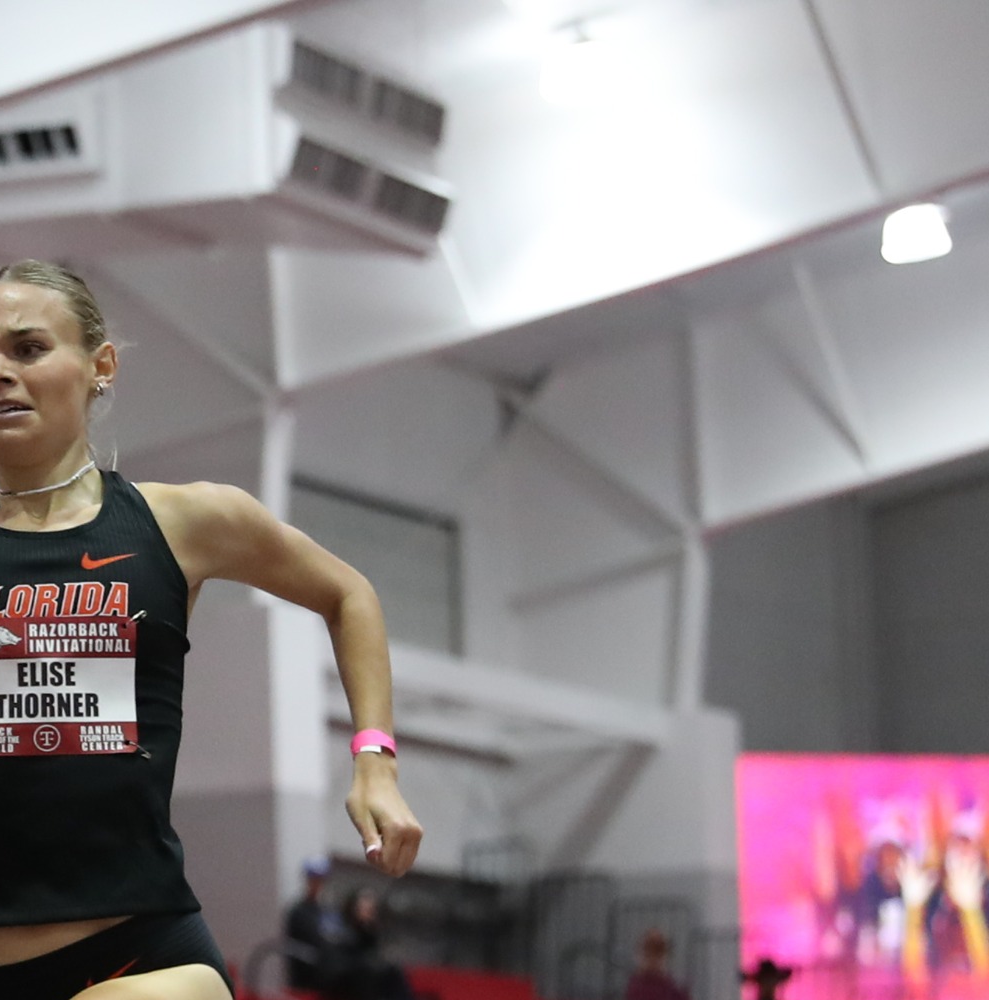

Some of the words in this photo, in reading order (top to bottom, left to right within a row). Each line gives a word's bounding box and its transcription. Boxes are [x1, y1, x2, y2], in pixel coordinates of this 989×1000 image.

[28, 622, 119, 638] RAZORBACK
[28, 638, 131, 653] INVITATIONAL
[16, 662, 77, 688] ELISE
[80, 725, 123, 735] RANDAL
[79, 734, 101, 742] TYSON
[102, 733, 124, 741] TRACK
[81, 740, 124, 751] CENTER
